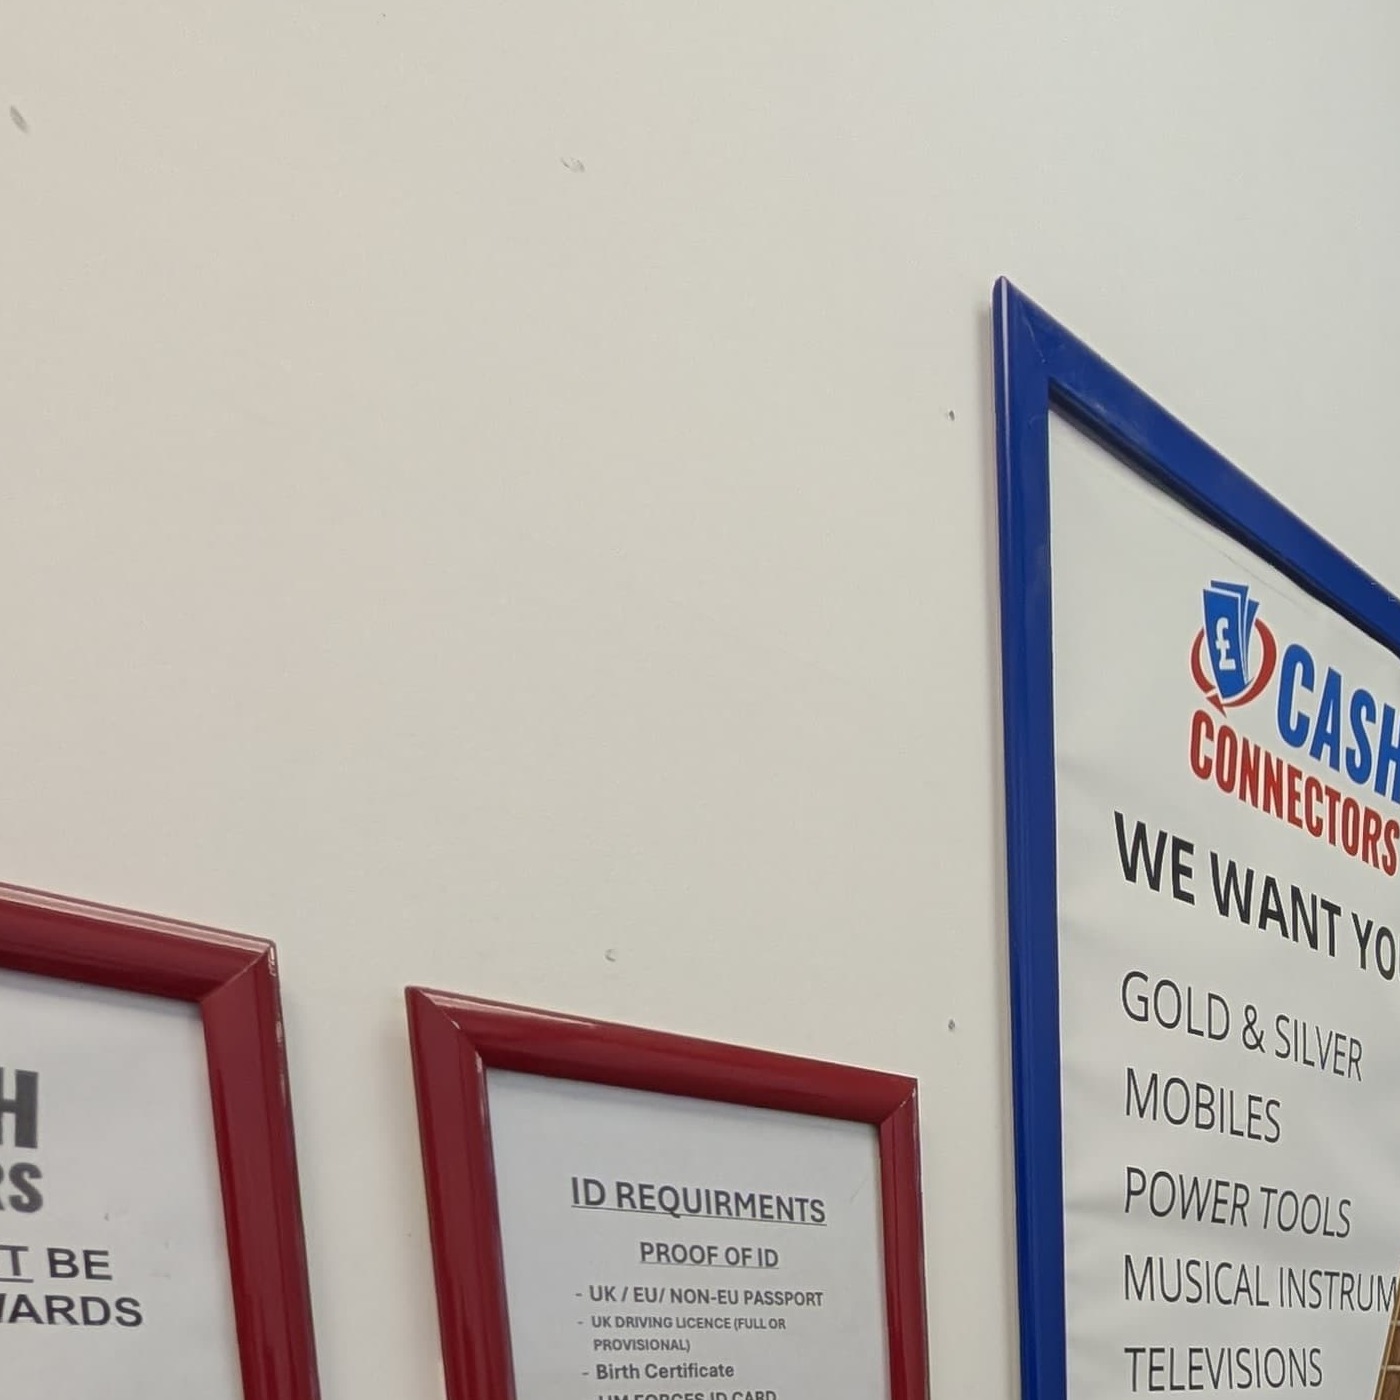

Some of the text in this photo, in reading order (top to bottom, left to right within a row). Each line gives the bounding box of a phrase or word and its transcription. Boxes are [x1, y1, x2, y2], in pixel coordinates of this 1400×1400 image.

[1190, 711, 1400, 876] CONNECTORS
[1114, 811, 1195, 906] WE
[1210, 852, 1341, 957] WANT
[1121, 970, 1362, 1082] GOLD & SILVER
[1126, 1067, 1281, 1143] MOBILES
[571, 1176, 826, 1223] ID REQUIRMENTS
[1125, 1166, 1351, 1238] POWER TOOLS
[47, 1247, 112, 1281] BE
[640, 1241, 779, 1267] PROOF OF ID
[589, 1285, 616, 1302] UK
[670, 1288, 739, 1305] NON-EU
[743, 1291, 823, 1307] PASSPORT
[1124, 1254, 1397, 1312] MUSICAL INSTRUM
[0, 1293, 143, 1327] ARDS
[591, 1316, 786, 1331] UK DRIVING LICENCE (FULL OR
[593, 1338, 691, 1353] PROVISIONAL)
[596, 1363, 735, 1380] Birth Certificate
[1124, 1347, 1322, 1392] TELEVISIONS
